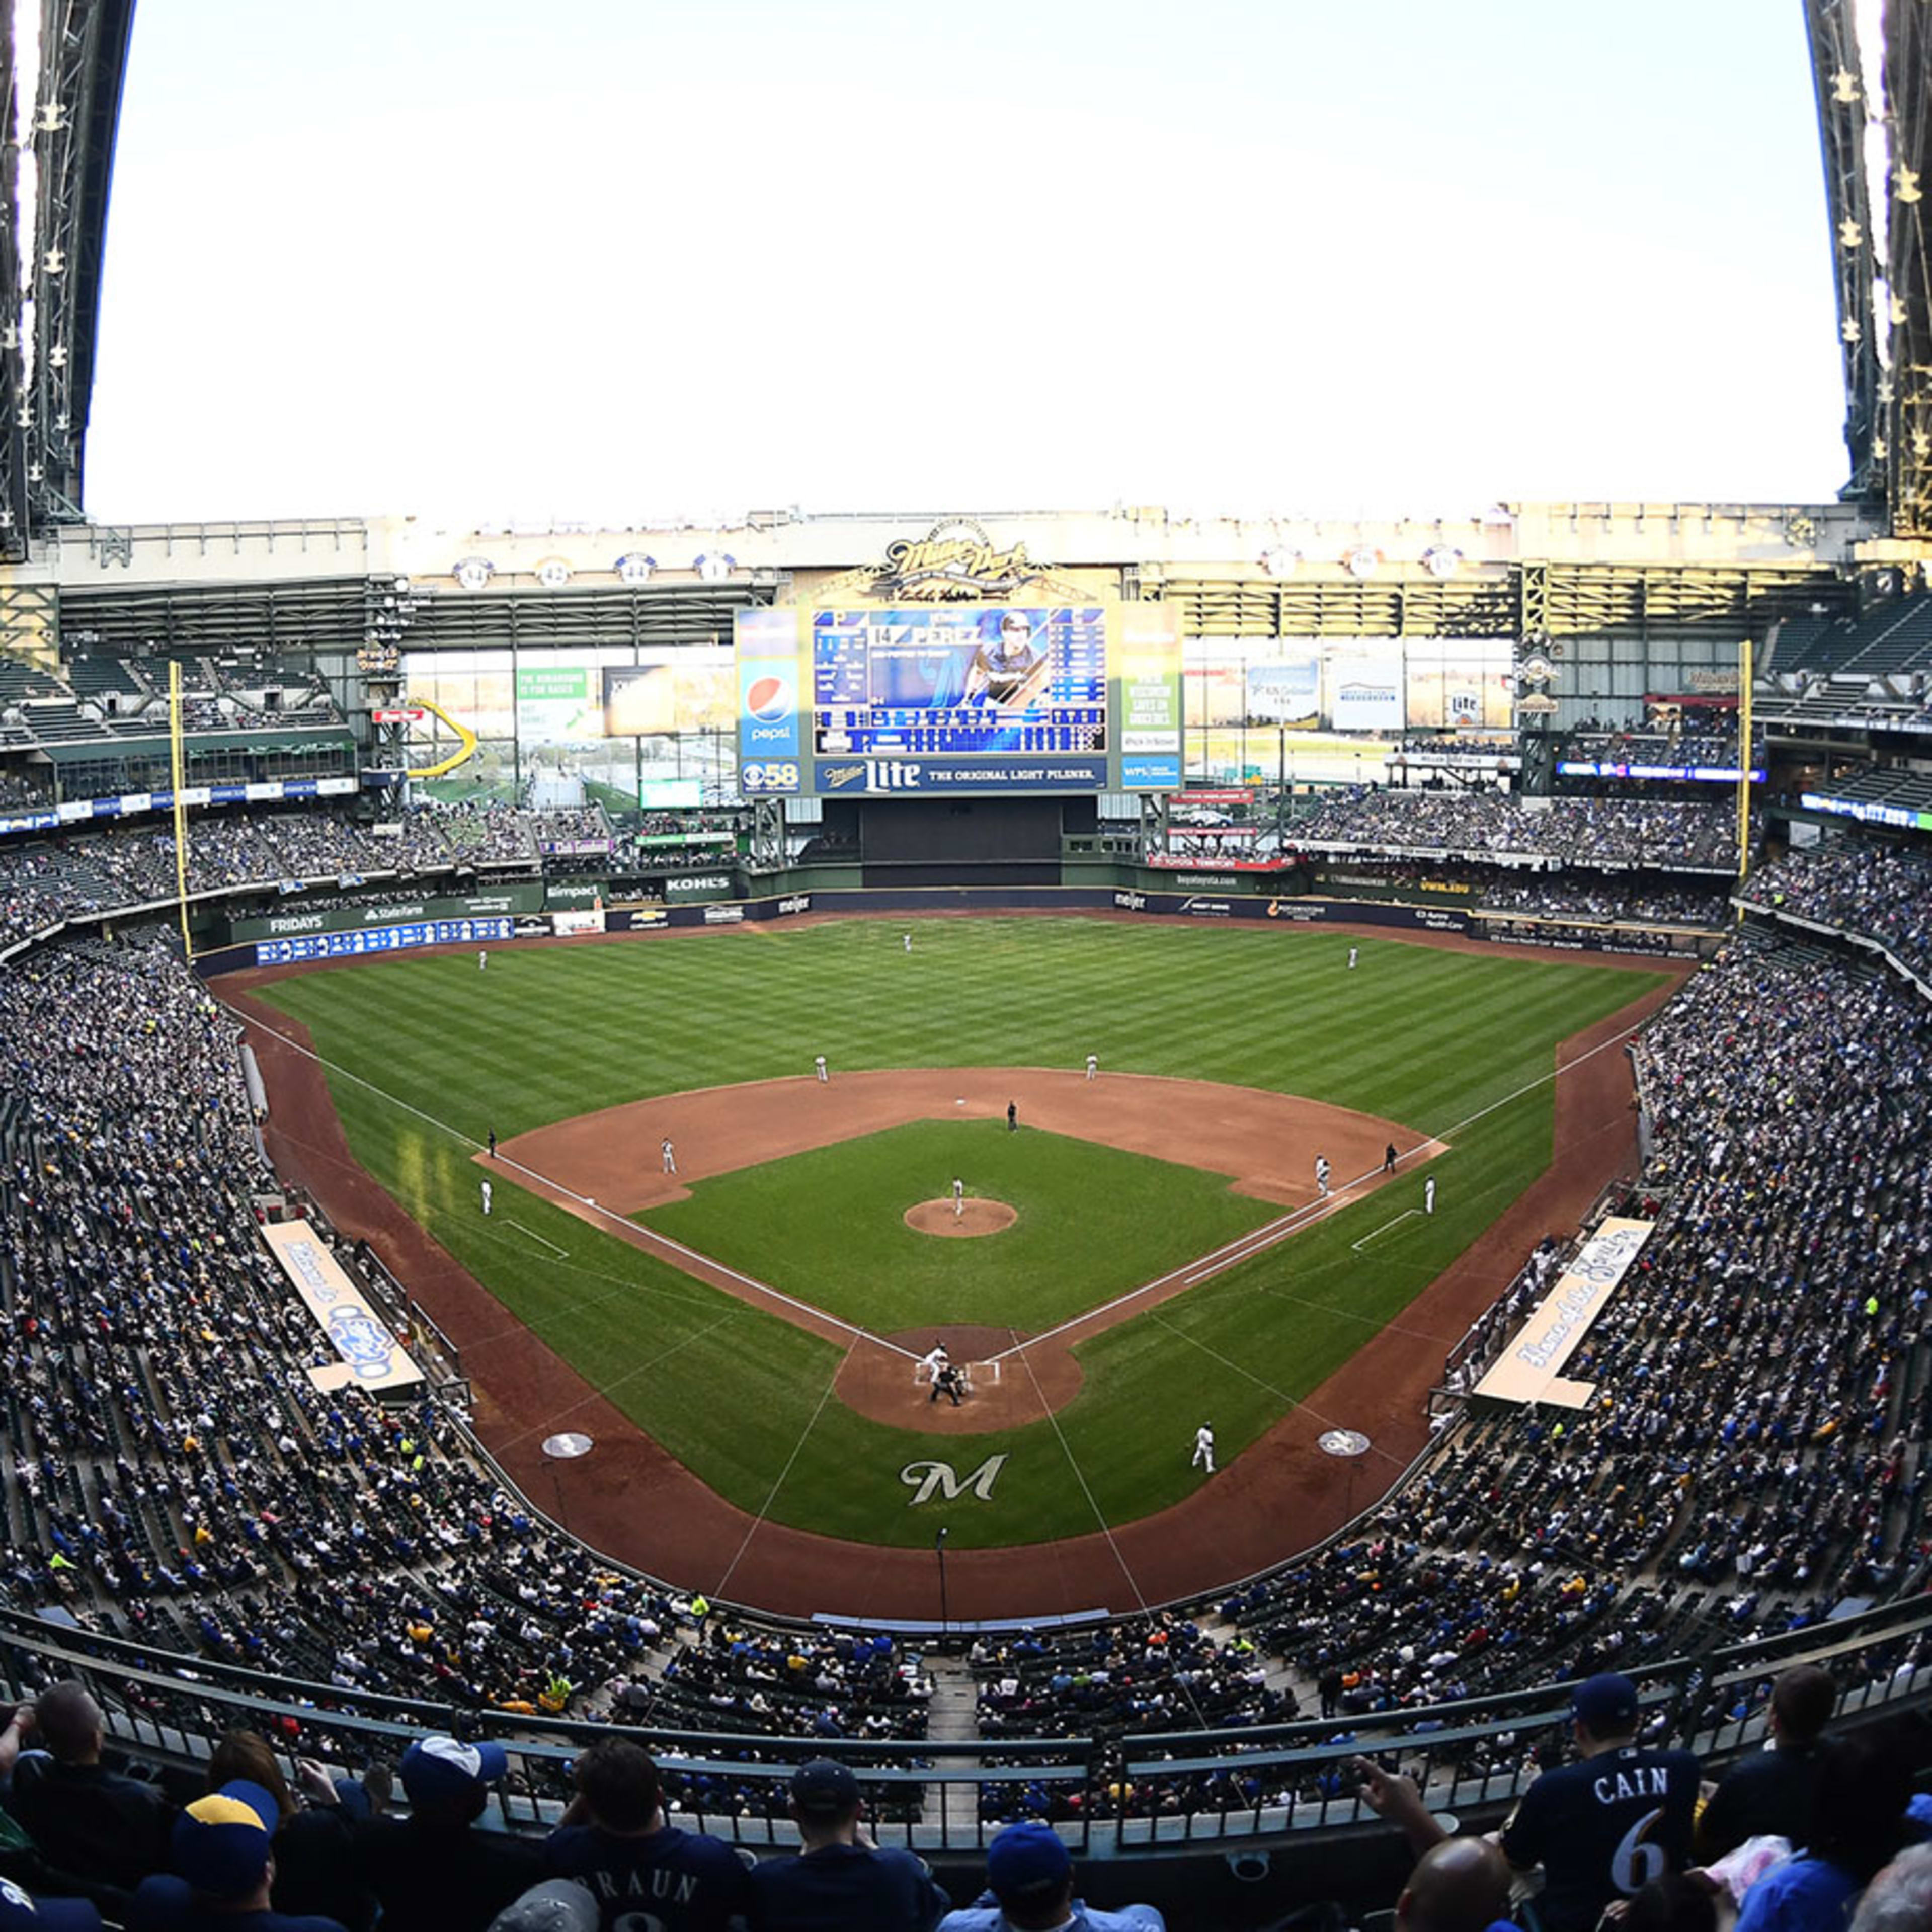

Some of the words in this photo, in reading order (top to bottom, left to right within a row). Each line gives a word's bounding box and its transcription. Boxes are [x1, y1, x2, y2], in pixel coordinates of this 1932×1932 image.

[875, 628, 891, 643] 14
[752, 728, 790, 740] pepsi
[765, 763, 799, 787] 58
[824, 765, 865, 788] Miller
[864, 760, 921, 793] Lite
[929, 771, 952, 780] THE
[955, 770, 1008, 780] ORIGINAL
[1010, 770, 1043, 779] LIGHT
[666, 876, 730, 892] KOHL'S
[778, 896, 810, 914] meijer
[1114, 892, 1146, 910] meijer
[270, 915, 323, 932] FRIDAYS
[900, 1453, 1010, 1506] M
[1594, 1767, 1667, 1805] CAIN
[1612, 1806, 1664, 1894] 6
